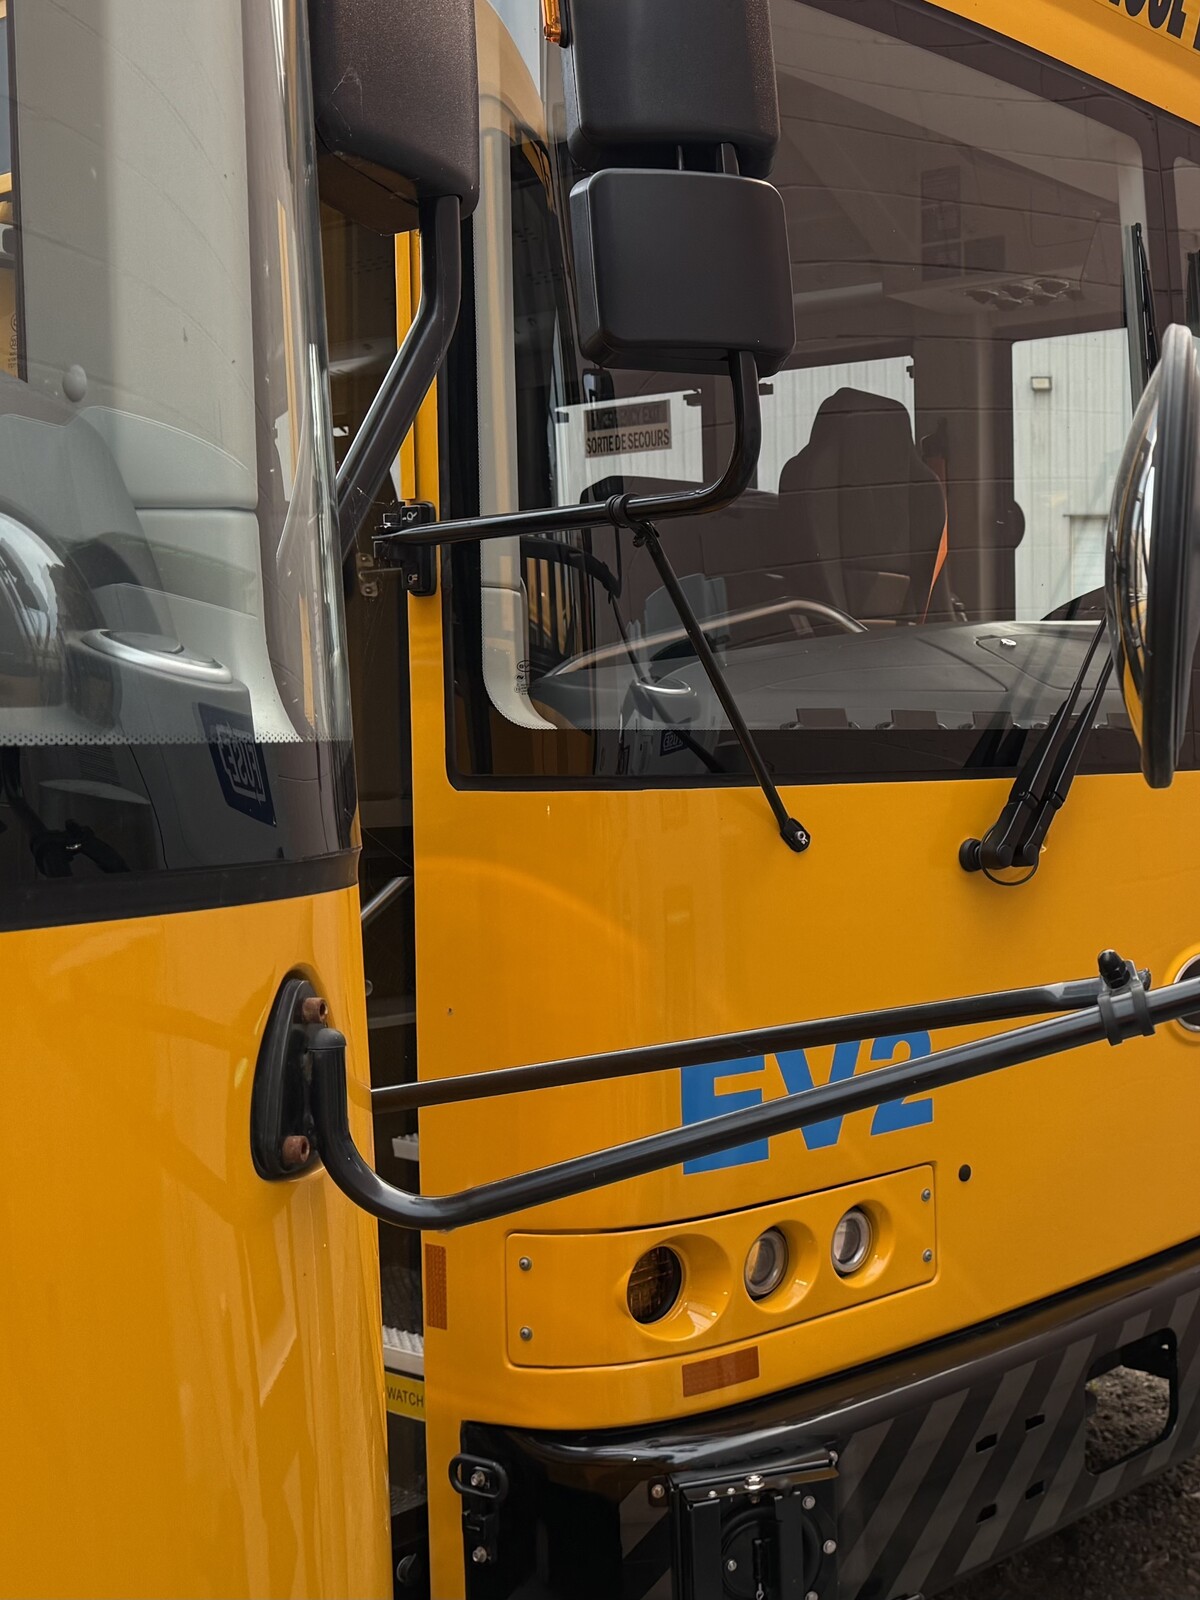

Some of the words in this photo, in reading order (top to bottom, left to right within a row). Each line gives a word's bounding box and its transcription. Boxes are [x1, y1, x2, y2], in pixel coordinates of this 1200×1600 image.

[586, 435, 614, 454] SORTIE
[615, 434, 627, 450] DE
[627, 428, 670, 449] SECOURS
[681, 1030, 933, 1175] EV2
[386, 1386, 424, 1408] WATCH
